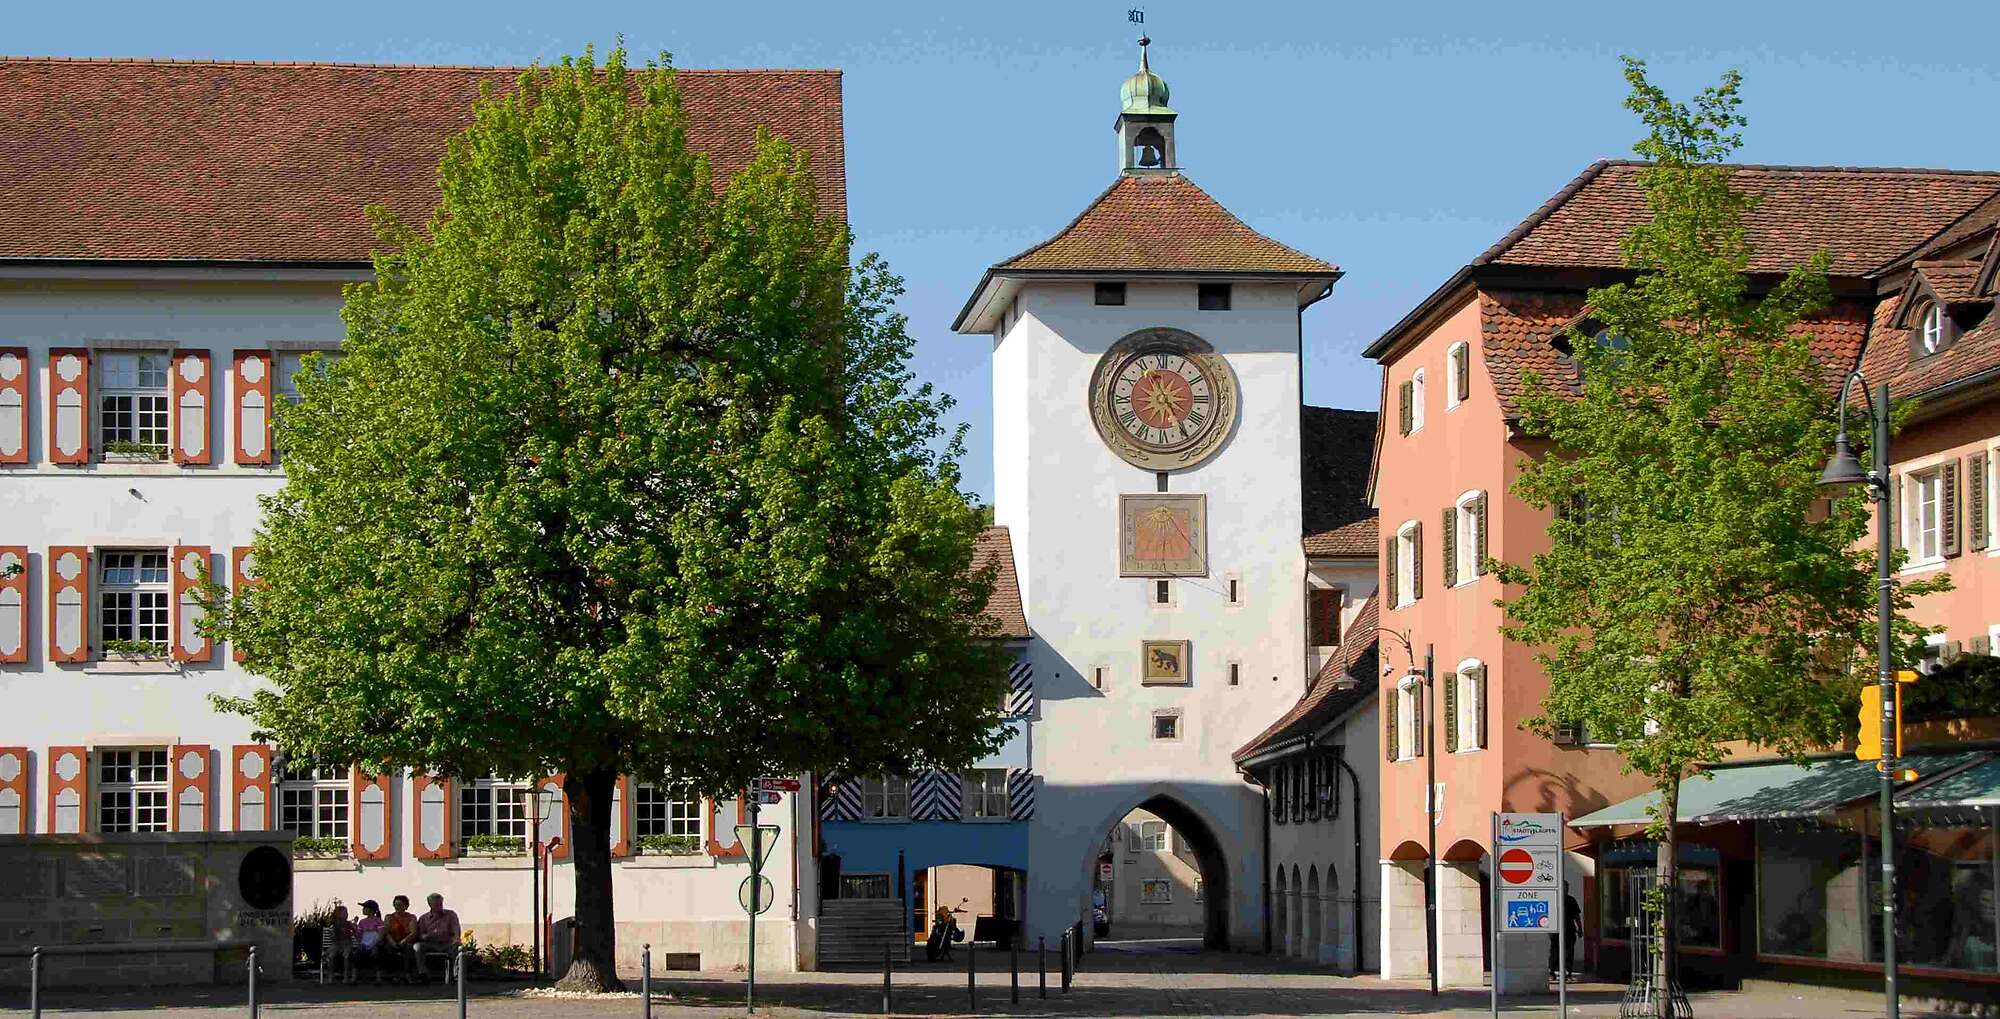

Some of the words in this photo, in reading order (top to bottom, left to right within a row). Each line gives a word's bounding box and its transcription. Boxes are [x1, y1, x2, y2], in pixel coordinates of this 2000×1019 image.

[1156, 355, 1168, 369] XII
[1177, 361, 1185, 372] I
[1121, 375, 1136, 386] X
[1189, 375, 1203, 385] II
[1116, 395, 1130, 404] IX
[1194, 395, 1208, 404] III
[1517, 891, 1538, 899] ZONE
